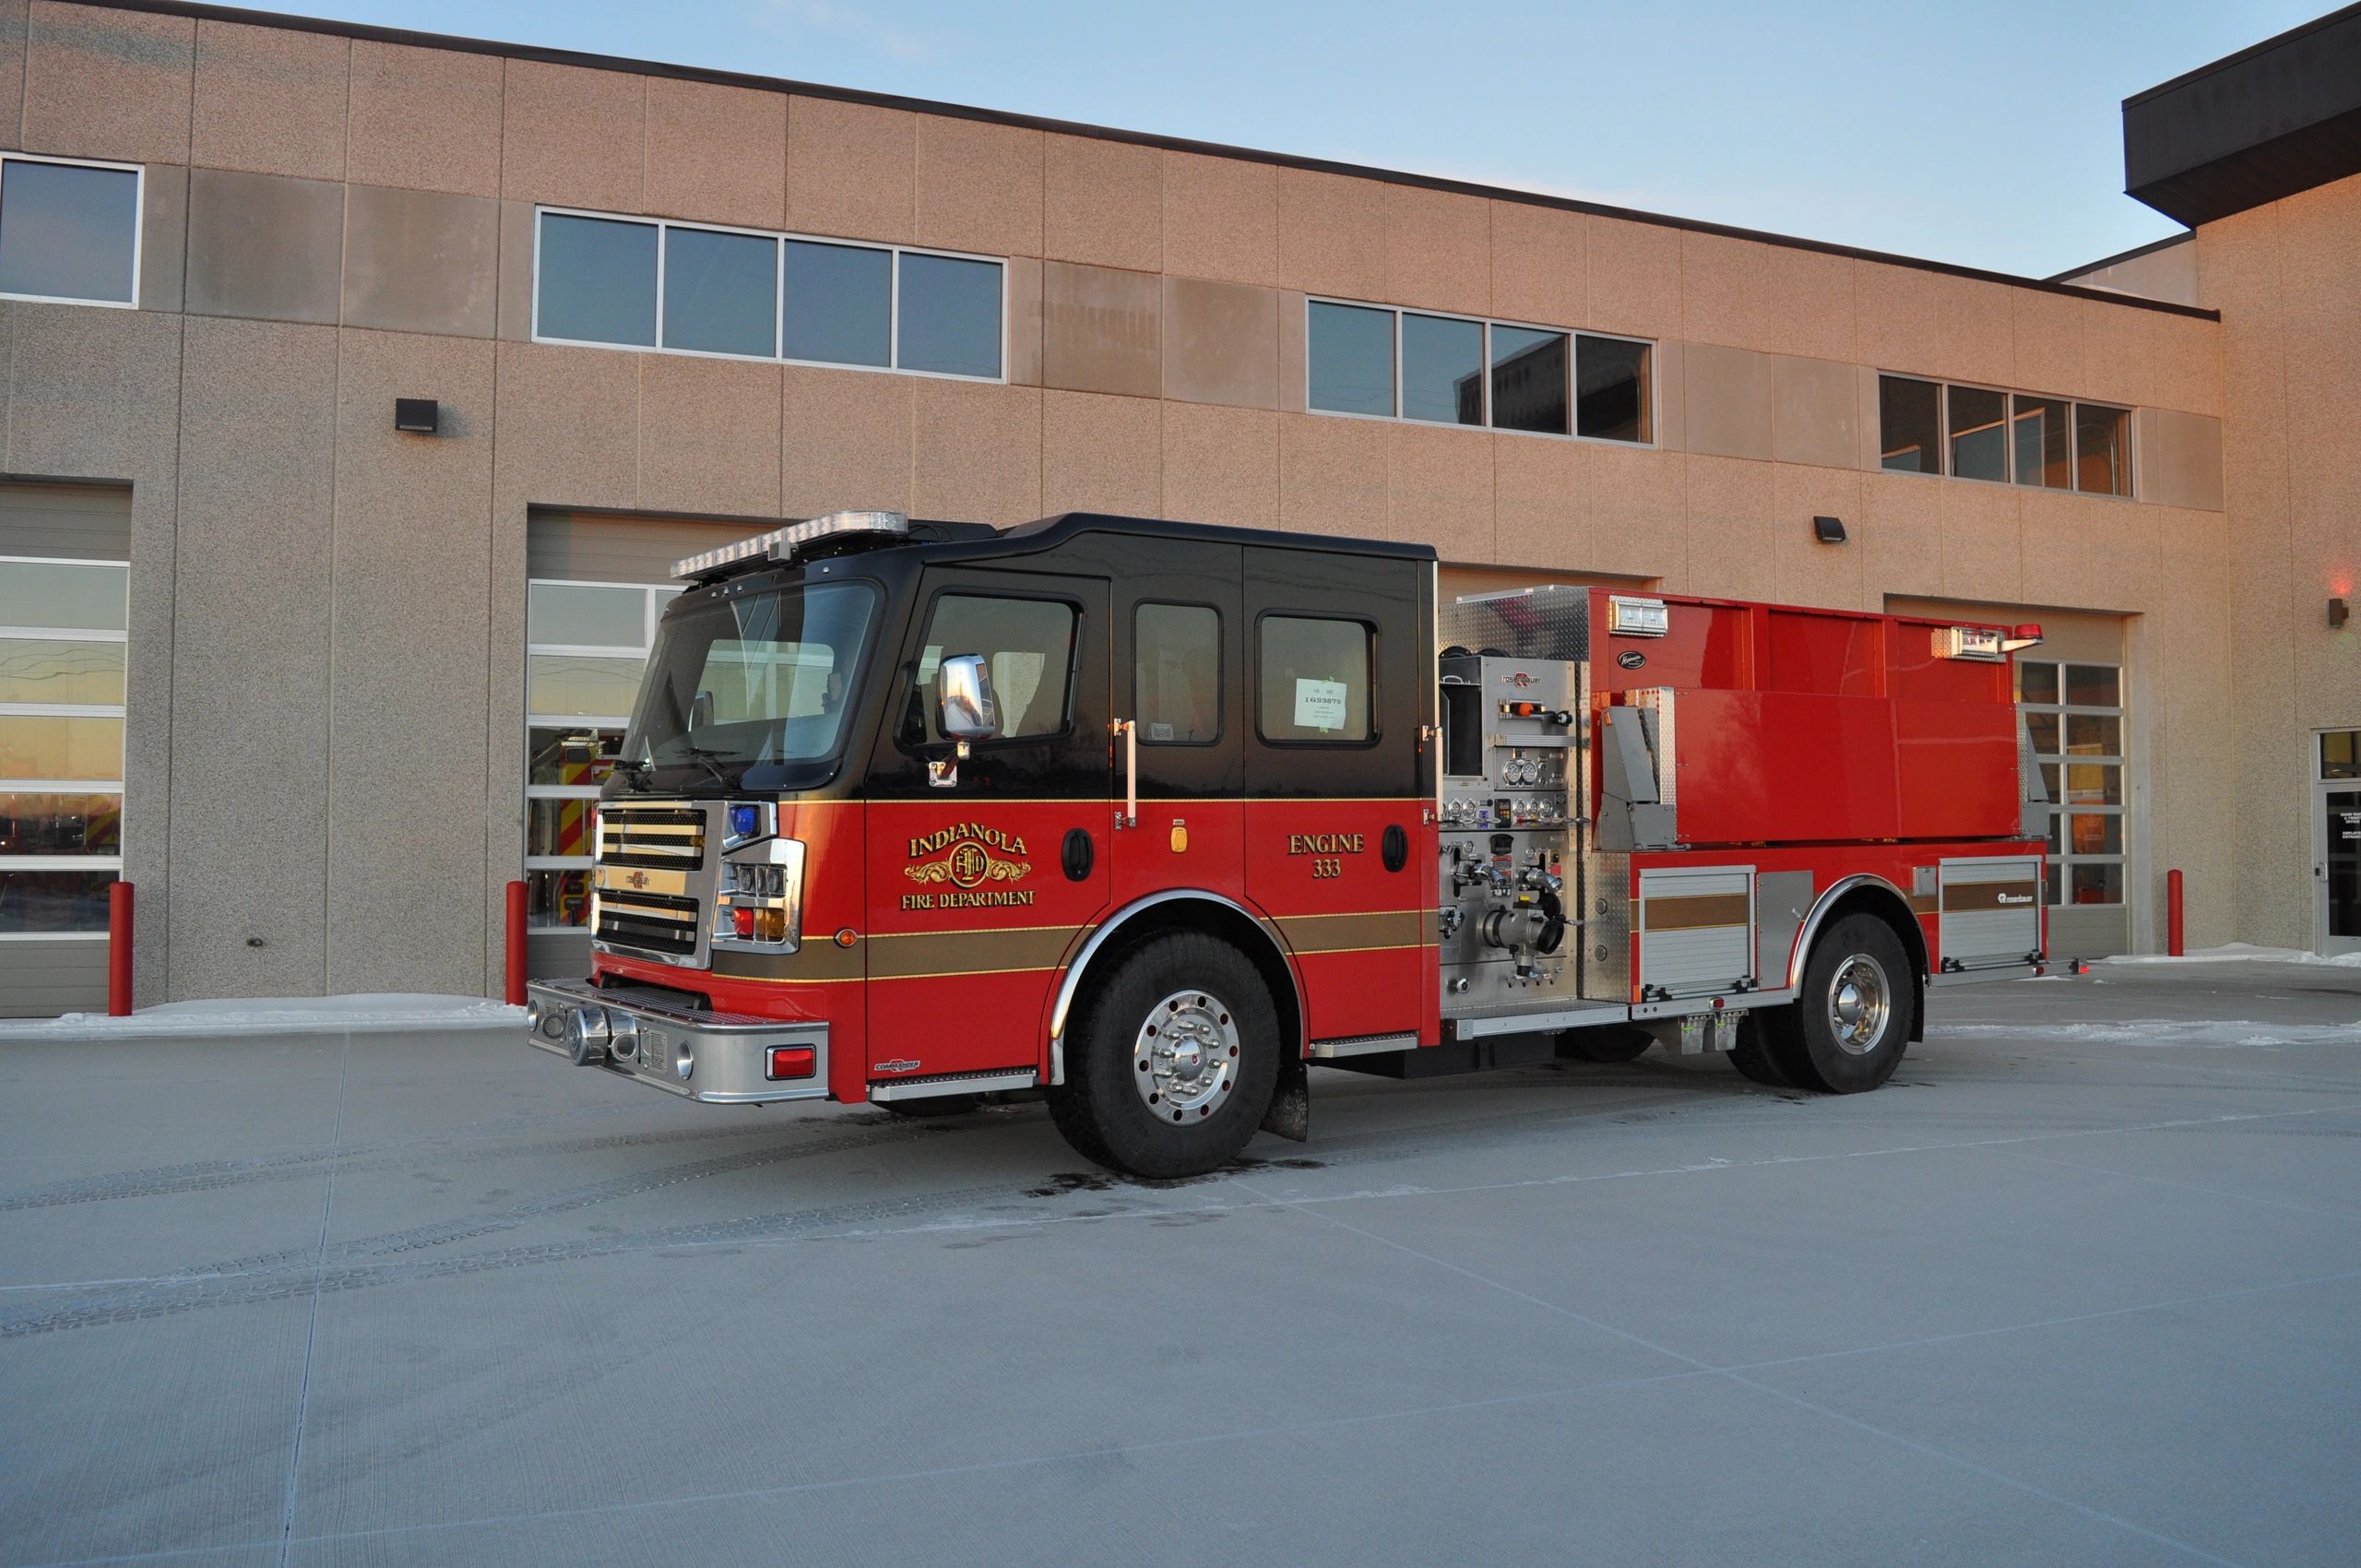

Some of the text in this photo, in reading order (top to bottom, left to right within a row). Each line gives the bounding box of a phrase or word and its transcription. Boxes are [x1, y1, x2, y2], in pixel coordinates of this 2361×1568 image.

[909, 822, 1027, 858] INDIANOLA
[1289, 834, 1364, 853] ENGINE
[1313, 859, 1341, 877] 333
[901, 890, 1036, 910] FIRE DEPARTMENT
